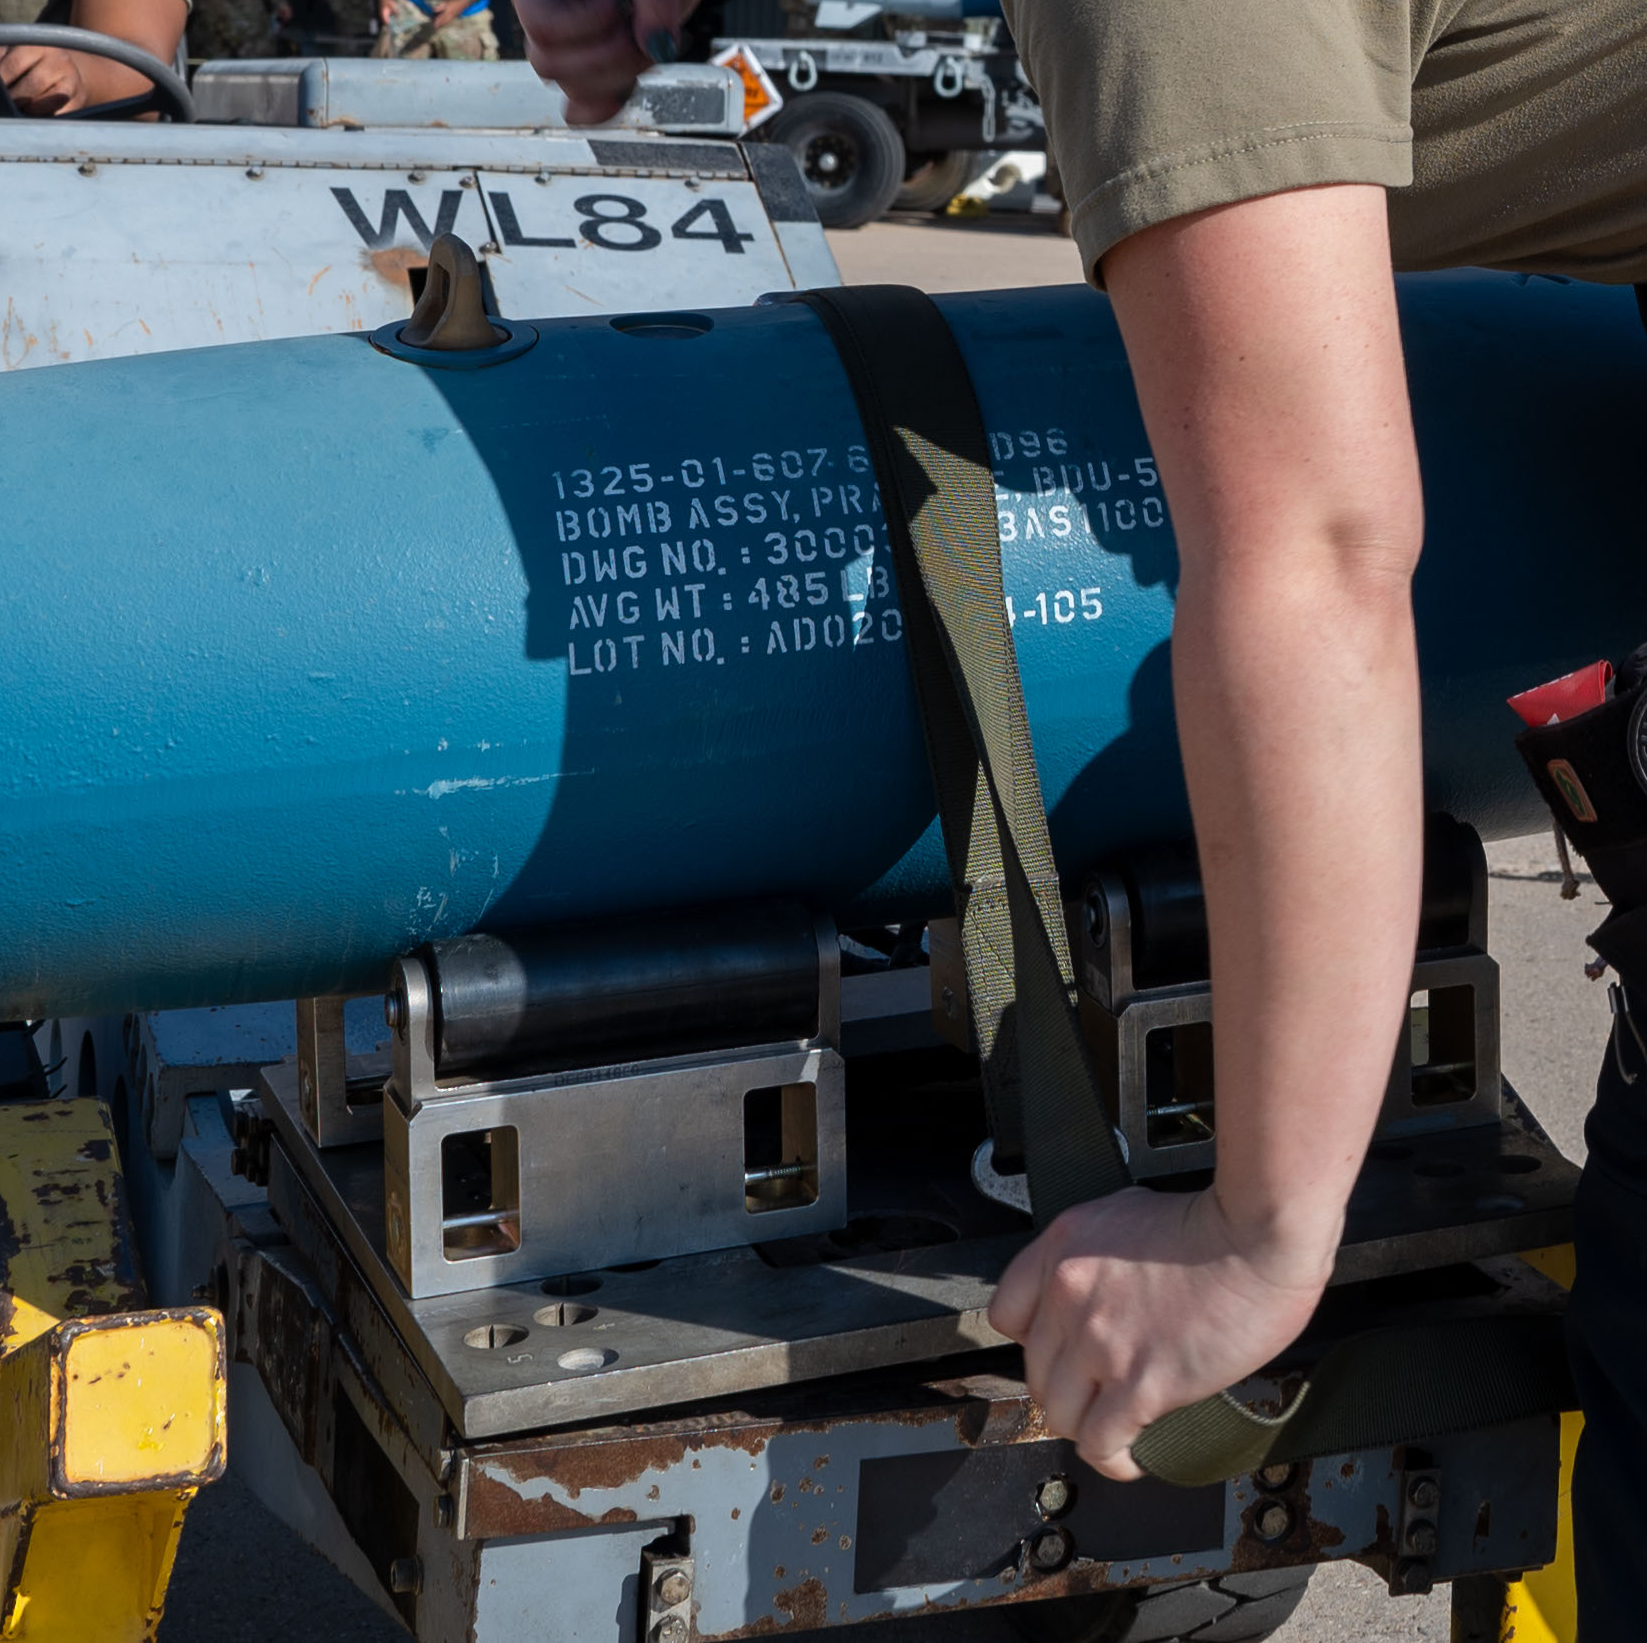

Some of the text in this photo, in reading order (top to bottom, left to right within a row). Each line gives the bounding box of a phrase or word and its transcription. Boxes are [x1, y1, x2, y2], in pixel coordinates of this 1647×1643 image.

[330, 186, 754, 255] WL84
[556, 500, 672, 542] BOMB
[689, 490, 800, 530] ASSY,
[562, 545, 648, 586] DWG
[661, 539, 727, 576] NO.
[764, 523, 892, 565] 3000
[569, 591, 641, 630] AVG
[655, 583, 706, 622] WT
[748, 571, 829, 611] 485
[568, 634, 645, 676] LOT
[661, 628, 725, 666] NO.
